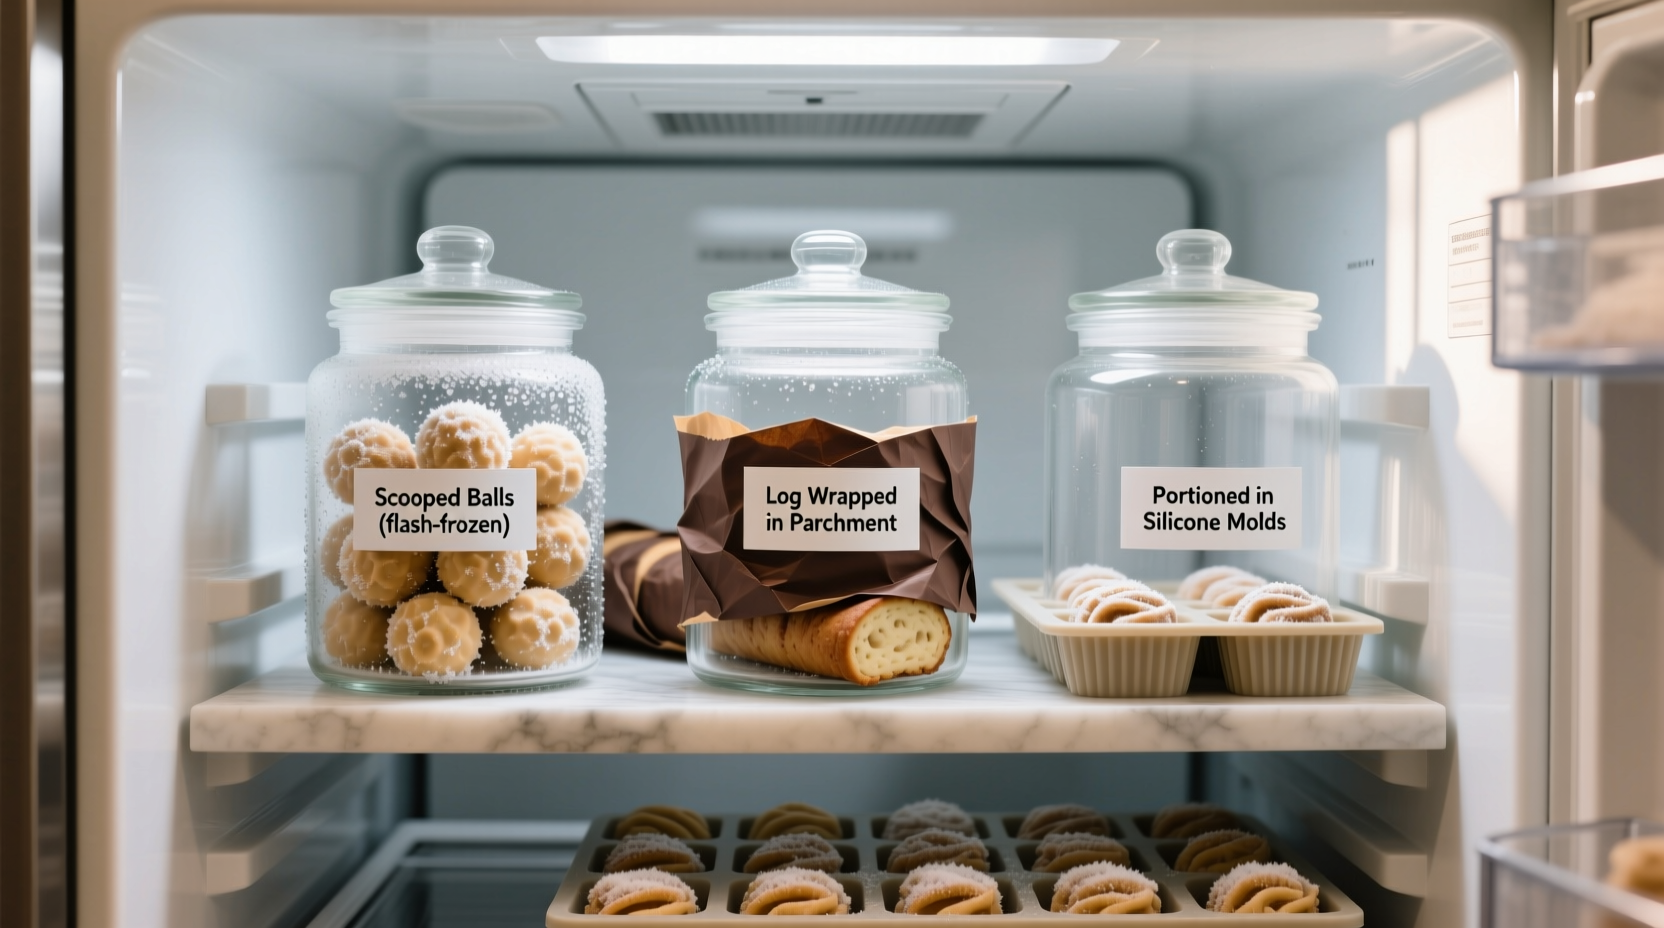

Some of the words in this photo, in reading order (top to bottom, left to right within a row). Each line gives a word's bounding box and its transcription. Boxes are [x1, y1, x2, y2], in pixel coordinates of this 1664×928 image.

[374, 486, 461, 513] Scooped
[467, 486, 515, 507] Balls
[766, 485, 802, 511] Log
[807, 485, 897, 511] Wrapped
[1153, 485, 1250, 505] Portioned
[1256, 485, 1274, 505] in
[378, 512, 510, 539] (flash-frozen)
[766, 511, 784, 532] in
[790, 512, 898, 532] Parchment
[1143, 510, 1221, 531] Silicone
[1227, 511, 1287, 531] Molds
